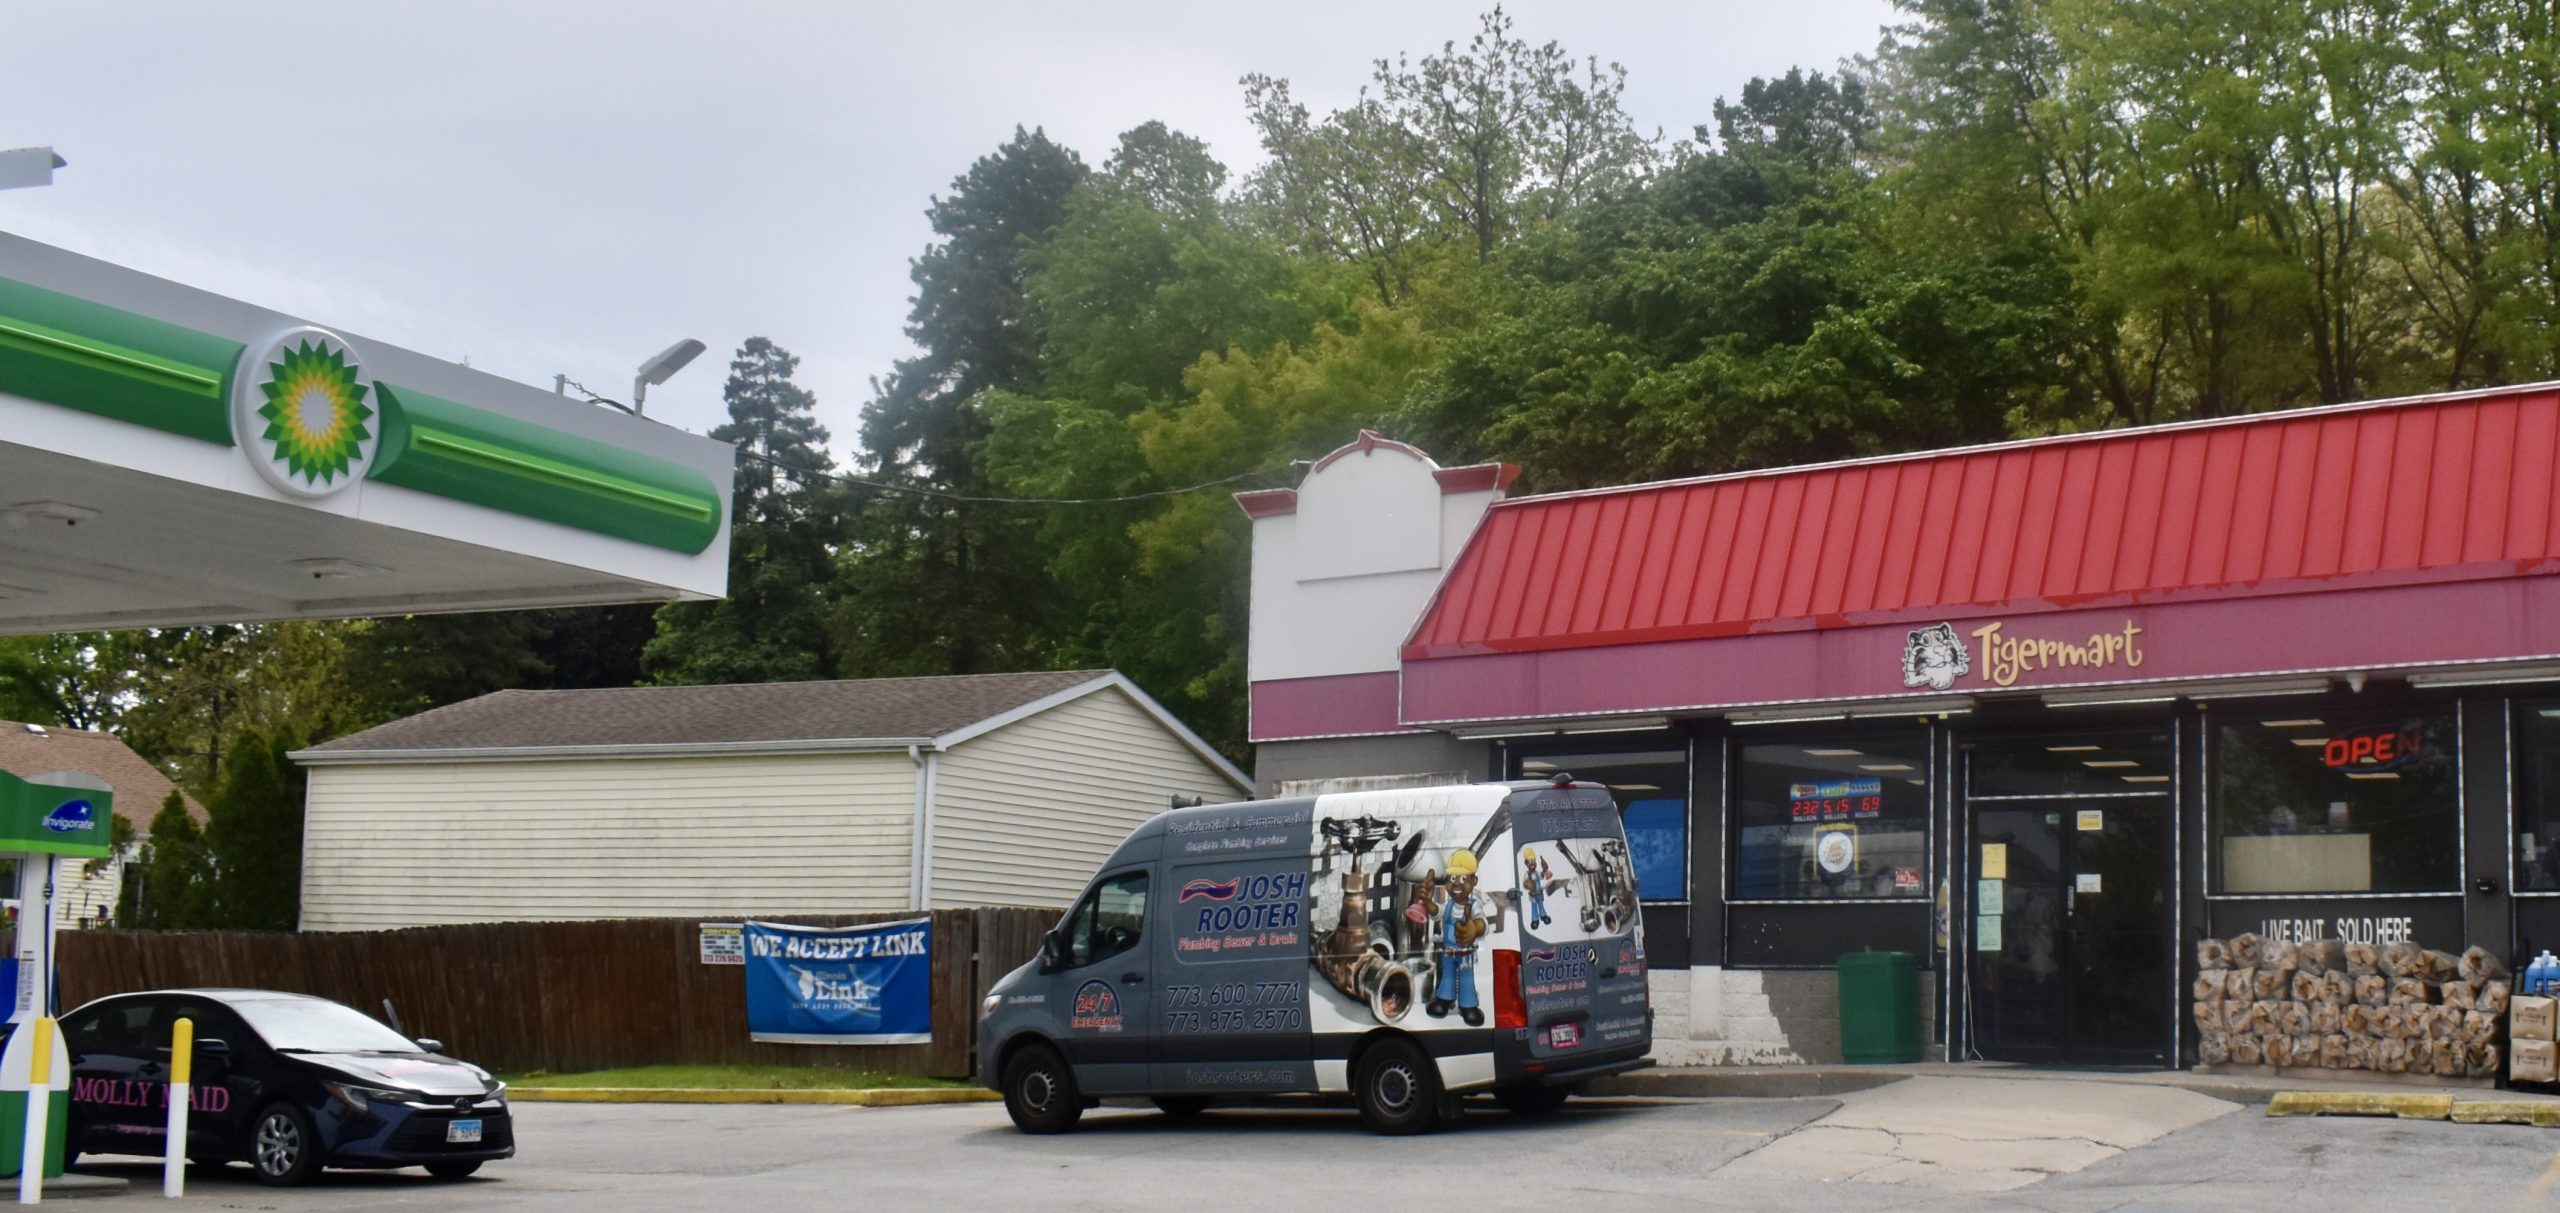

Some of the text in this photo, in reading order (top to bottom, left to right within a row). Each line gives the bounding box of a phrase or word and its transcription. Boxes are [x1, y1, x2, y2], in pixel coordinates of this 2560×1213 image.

[1972, 619, 2143, 687] Tigermart
[2325, 731, 2420, 767] OPEN
[1792, 801, 1820, 815] 232
[1862, 796, 1880, 811] 69
[42, 815, 95, 831] Invigorate
[1237, 872, 1307, 902] JOSH
[1196, 901, 1300, 933] ROOTER
[1178, 932, 1298, 952] Plumbing Sewer & Drain
[2294, 919, 2324, 946] BAIT
[2336, 917, 2373, 945] SOLD
[2375, 917, 2412, 945] HERE
[750, 931, 926, 959] WE ACCEPT LINK
[1556, 944, 1587, 963] JOSH
[1536, 962, 1586, 984] ROOTER
[815, 980, 869, 1000] Link
[1076, 992, 1113, 1013] 24/7
[1167, 982, 1300, 1007] 773.600.7771
[1167, 1008, 1302, 1033] 773.875.2570
[1186, 1068, 1296, 1088] joshrooters.com
[73, 1077, 153, 1107] MOLLY
